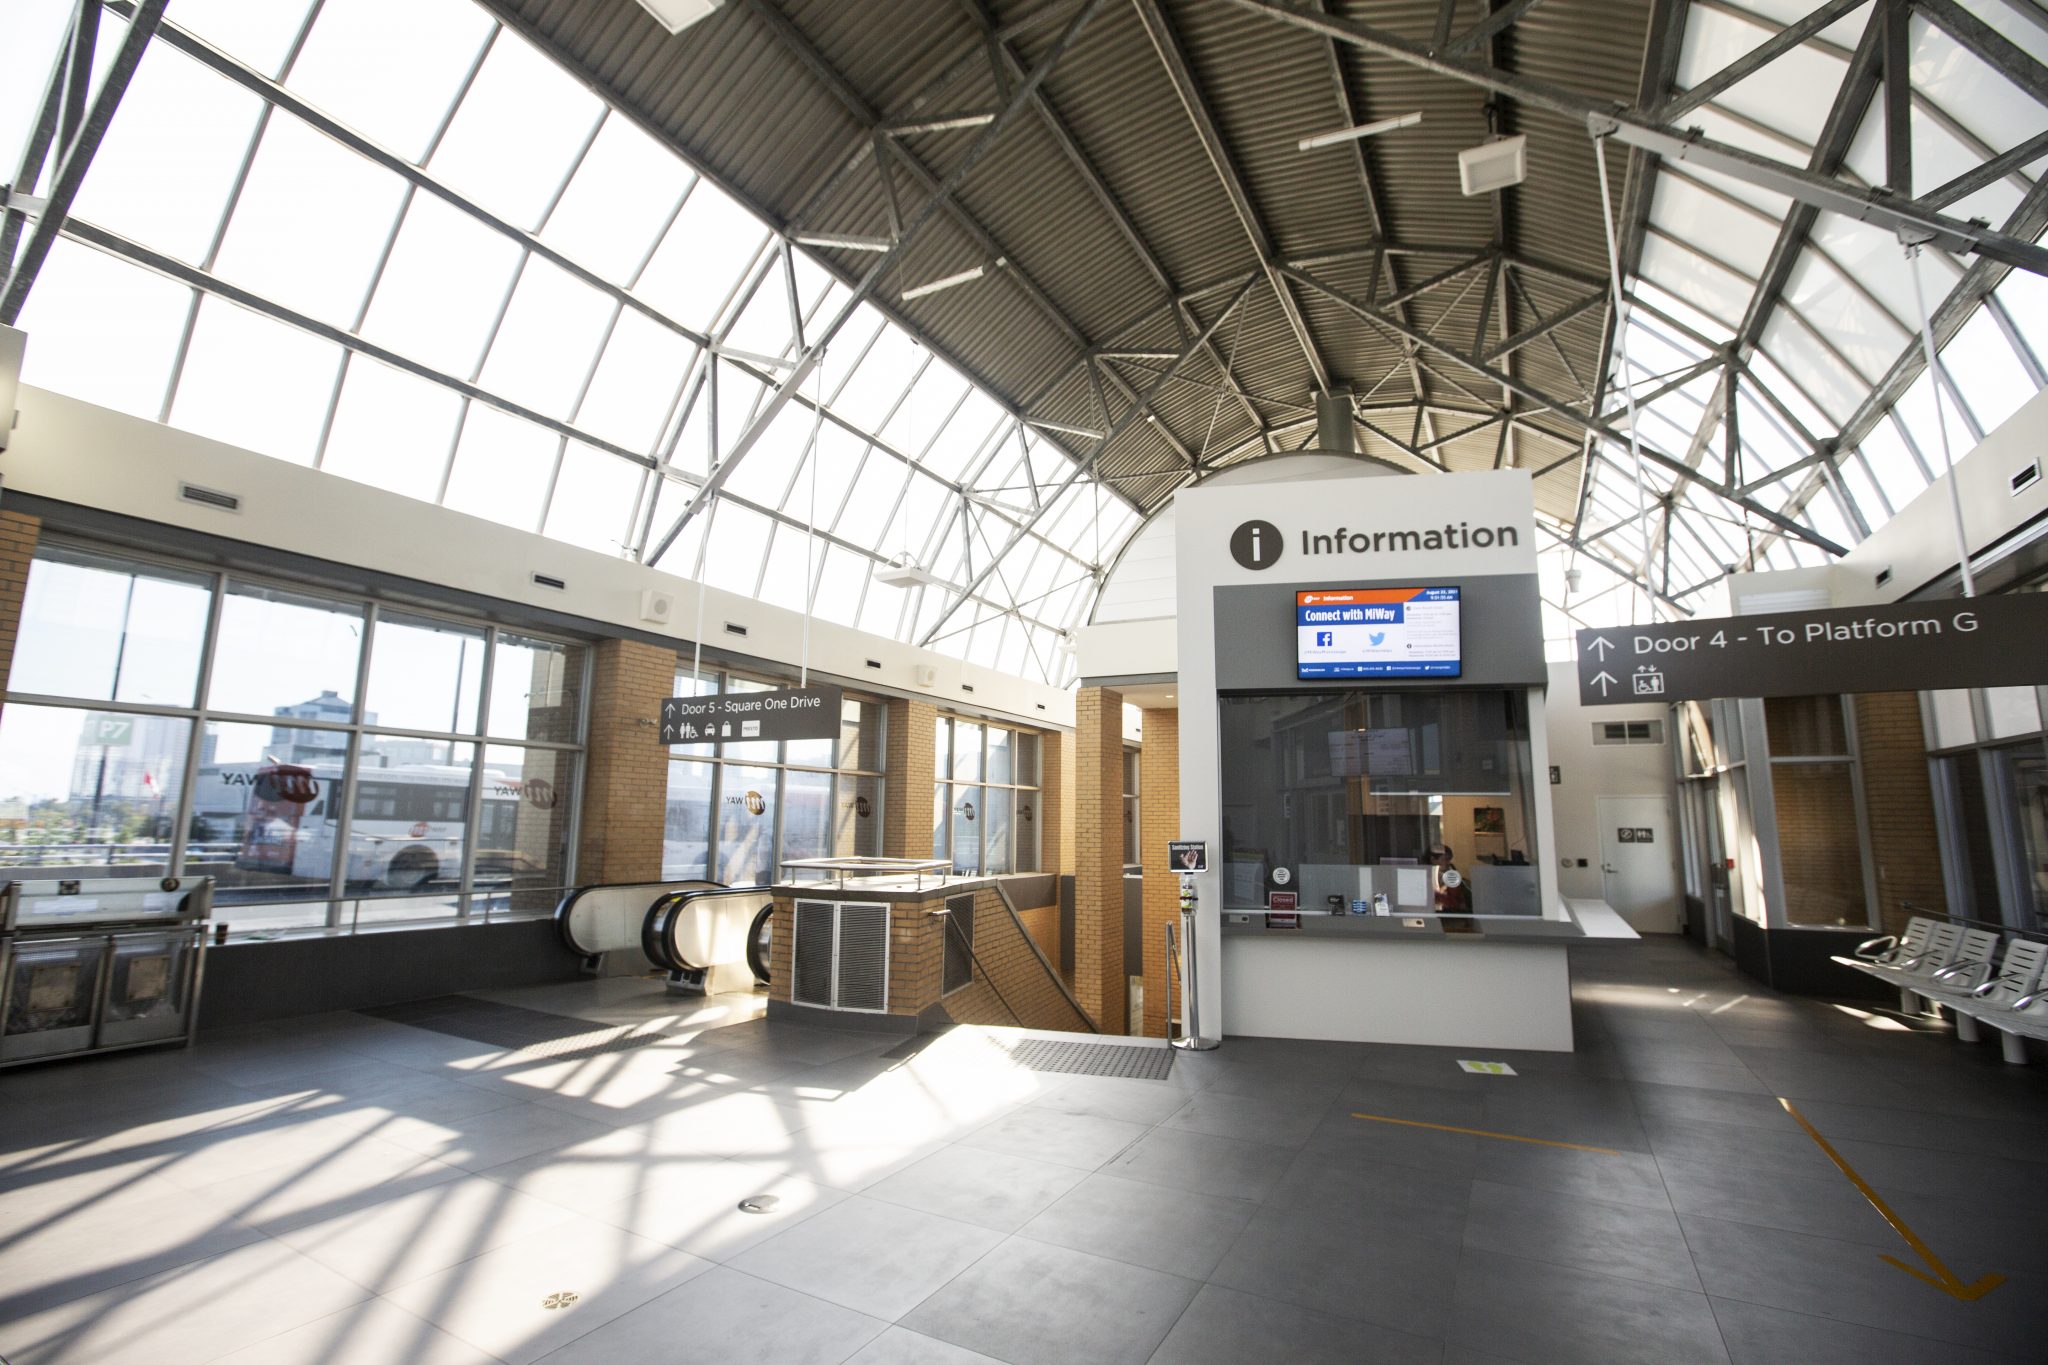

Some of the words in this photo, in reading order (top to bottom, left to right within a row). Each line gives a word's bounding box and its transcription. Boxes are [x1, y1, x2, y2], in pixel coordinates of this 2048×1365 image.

[1302, 521, 1519, 555] Information
[1305, 609, 1341, 622] Connect
[1342, 608, 1363, 621] with
[1365, 607, 1395, 622] MiWay
[1633, 634, 1700, 655] Door
[1709, 630, 1728, 649] 4
[1756, 626, 1795, 646] To
[1805, 616, 1941, 643] Platform
[1953, 612, 1979, 632] G
[681, 703, 706, 715] Door
[708, 702, 715, 713] 5
[725, 700, 762, 714] Square
[765, 698, 787, 710] One
[791, 695, 821, 709] Drive
[99, 720, 131, 739] P7
